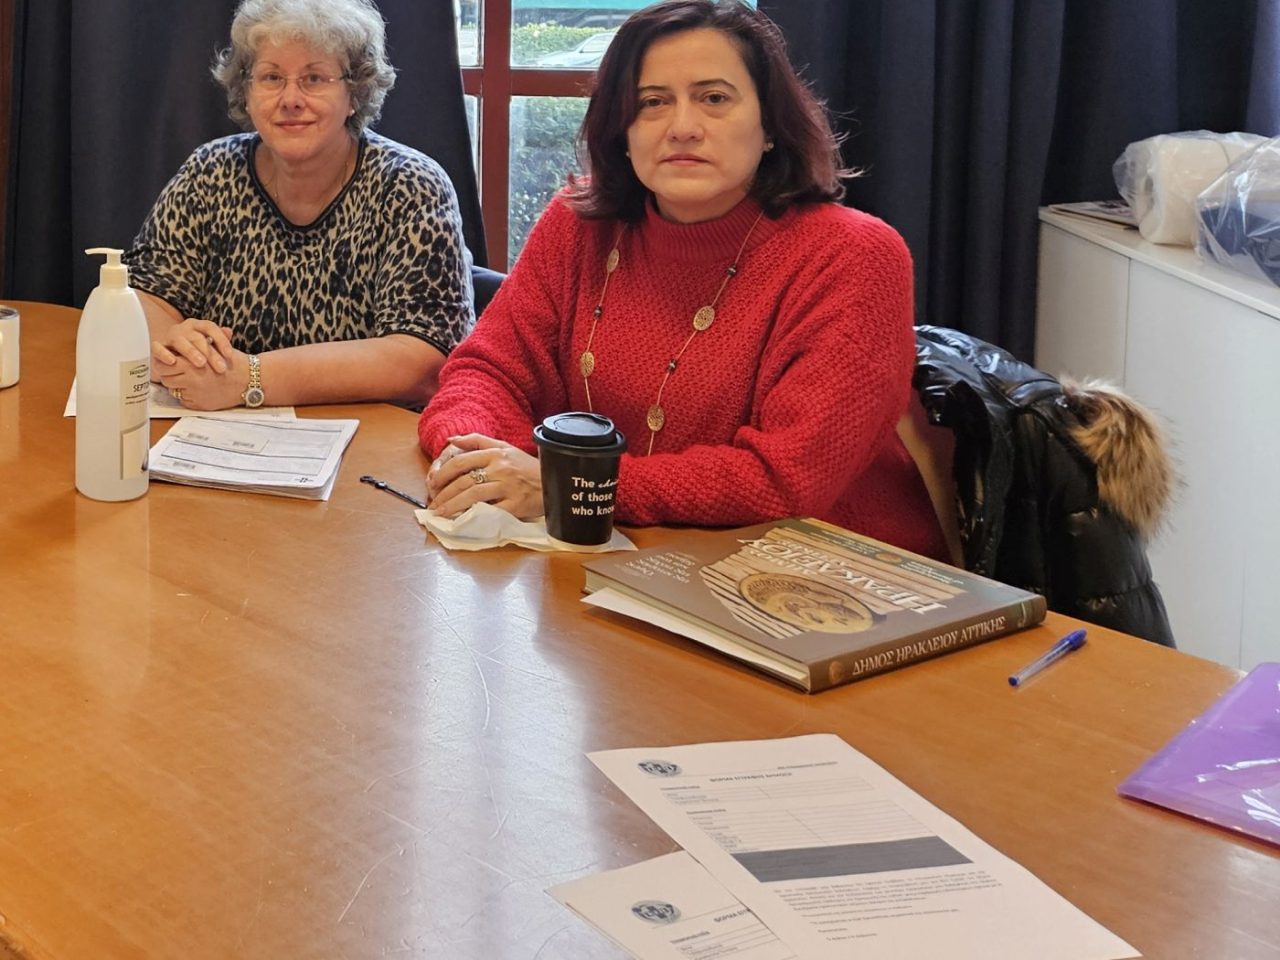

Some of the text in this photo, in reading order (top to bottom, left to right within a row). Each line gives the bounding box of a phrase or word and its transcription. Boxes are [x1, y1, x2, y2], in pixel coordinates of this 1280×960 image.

[571, 476, 595, 488] The
[571, 491, 613, 502] of those
[571, 505, 593, 516] who
[736, 538, 948, 616] ΗΡΑΚΛΕΙΟΥ
[852, 616, 1006, 676] ΔΗΜΟΣ ΗΡΑΚΛΕΙΟΥ ΑΤΤΙΚΗΣ
